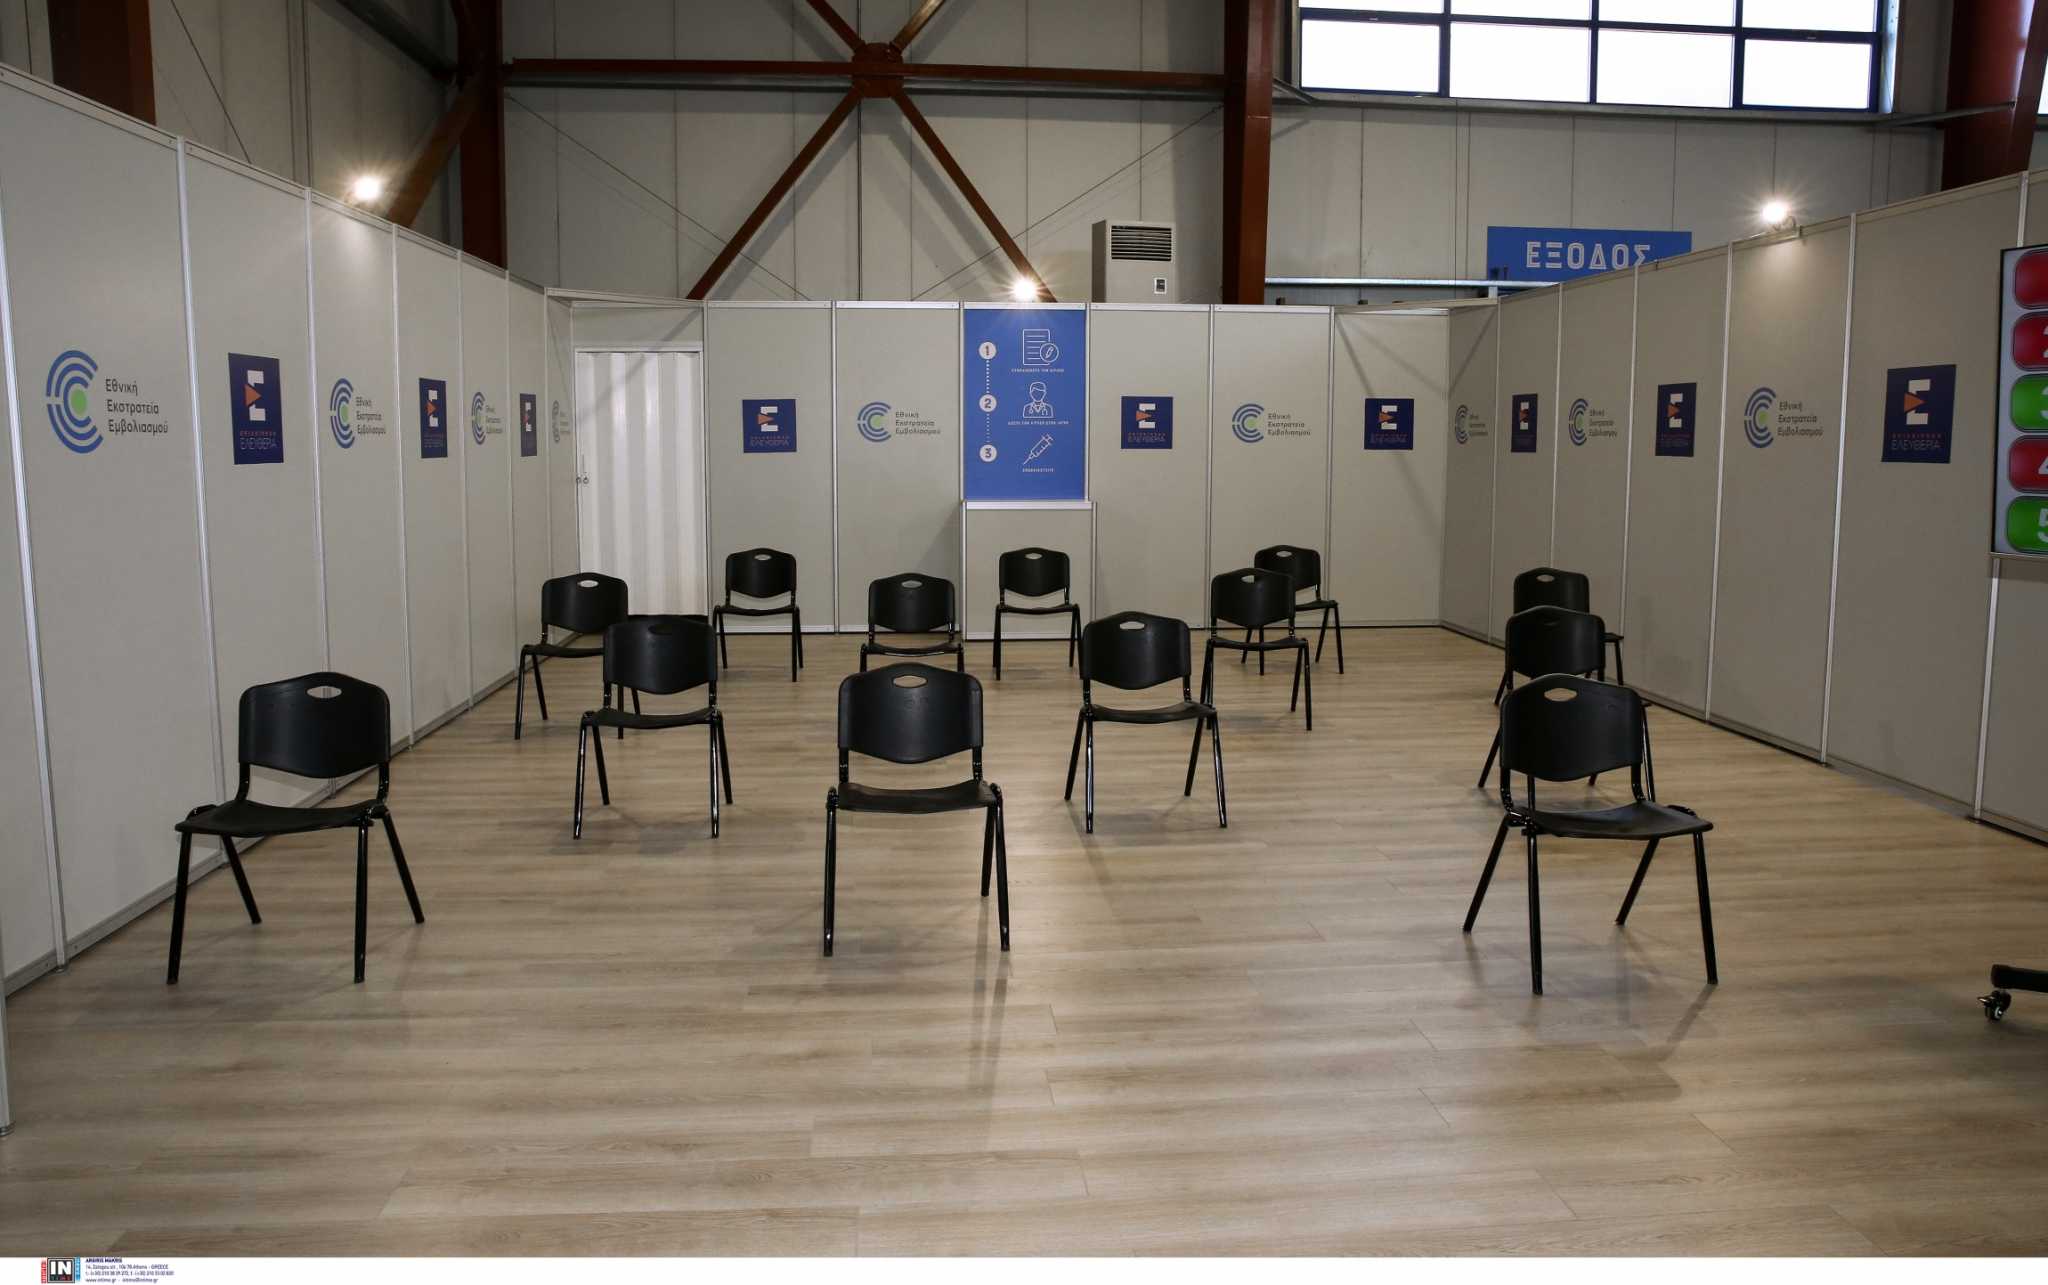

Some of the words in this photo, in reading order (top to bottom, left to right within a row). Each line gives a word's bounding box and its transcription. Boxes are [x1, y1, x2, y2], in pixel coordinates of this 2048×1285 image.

[1526, 241, 1650, 270] ΕΞΟΔΟΣ
[105, 379, 138, 396] Εθνική
[106, 399, 160, 416] Εκστρατεία
[984, 398, 992, 409] 2
[108, 419, 169, 436] Εμβολιασμού
[984, 447, 992, 459] 3
